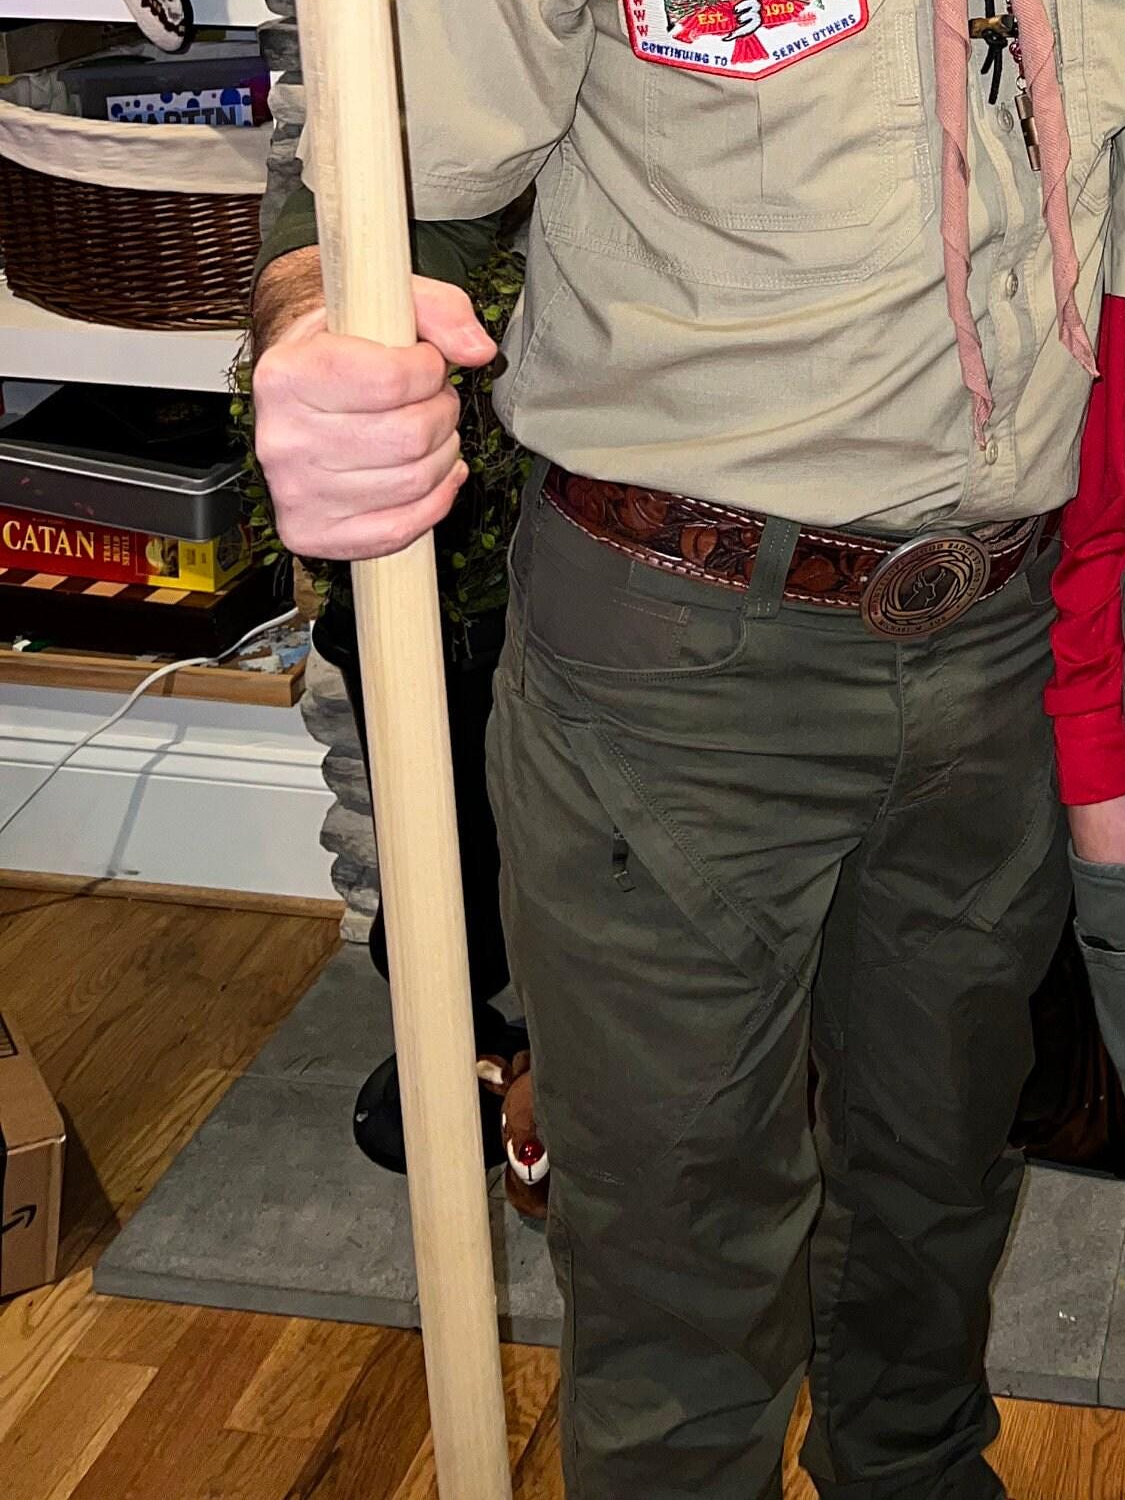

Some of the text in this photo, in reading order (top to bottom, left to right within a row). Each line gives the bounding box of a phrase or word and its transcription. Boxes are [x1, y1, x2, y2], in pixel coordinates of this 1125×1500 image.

[641, 40, 728, 67] CONTINUING TO
[772, 14, 857, 61] SERVE OTHERS
[2, 520, 95, 560] CATAN
